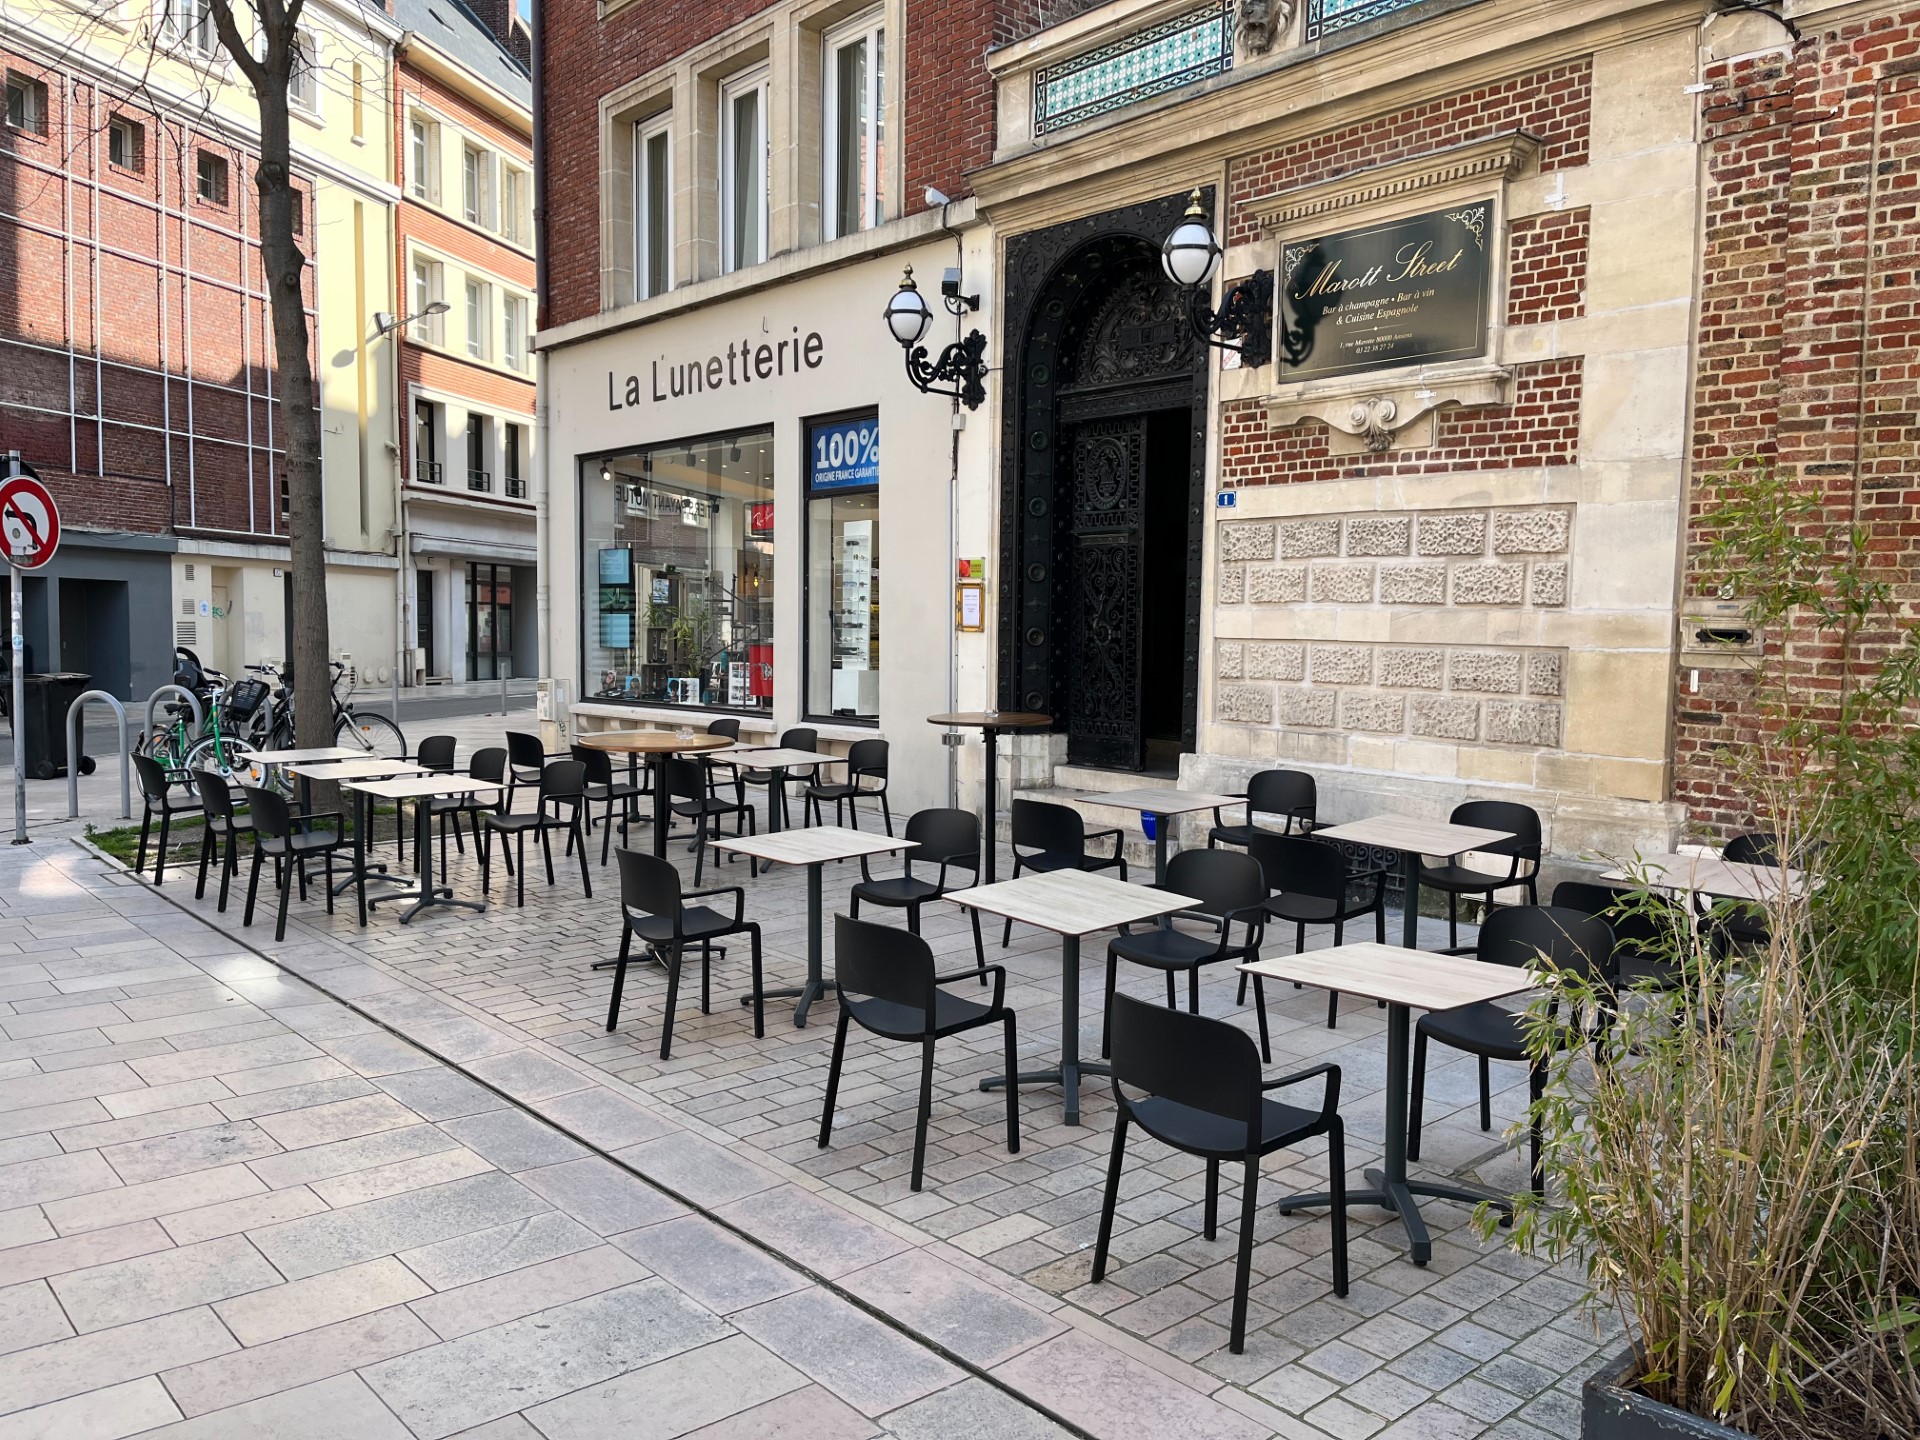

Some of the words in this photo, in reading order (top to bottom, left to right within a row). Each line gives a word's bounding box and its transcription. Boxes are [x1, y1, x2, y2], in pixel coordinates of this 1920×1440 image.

[1294, 258, 1383, 300] Marott
[1386, 240, 1463, 282] Street
[1322, 305, 1336, 316] Bar
[1338, 303, 1344, 312] à
[1345, 297, 1390, 312] champagne
[1397, 292, 1412, 303] Bar
[1413, 289, 1420, 299] à
[1422, 288, 1435, 298] vin
[1336, 316, 1343, 326] &
[1345, 312, 1375, 324] Cuisine
[1376, 303, 1419, 319] Espagnole
[1356, 346, 1363, 354] 03
[608, 370, 640, 411] La
[651, 326, 823, 402] Lunetterie
[816, 427, 879, 469] 100%
[815, 471, 835, 483] ORIGINE
[835, 468, 854, 480] FRANCE
[1223, 494, 1228, 505] 1
